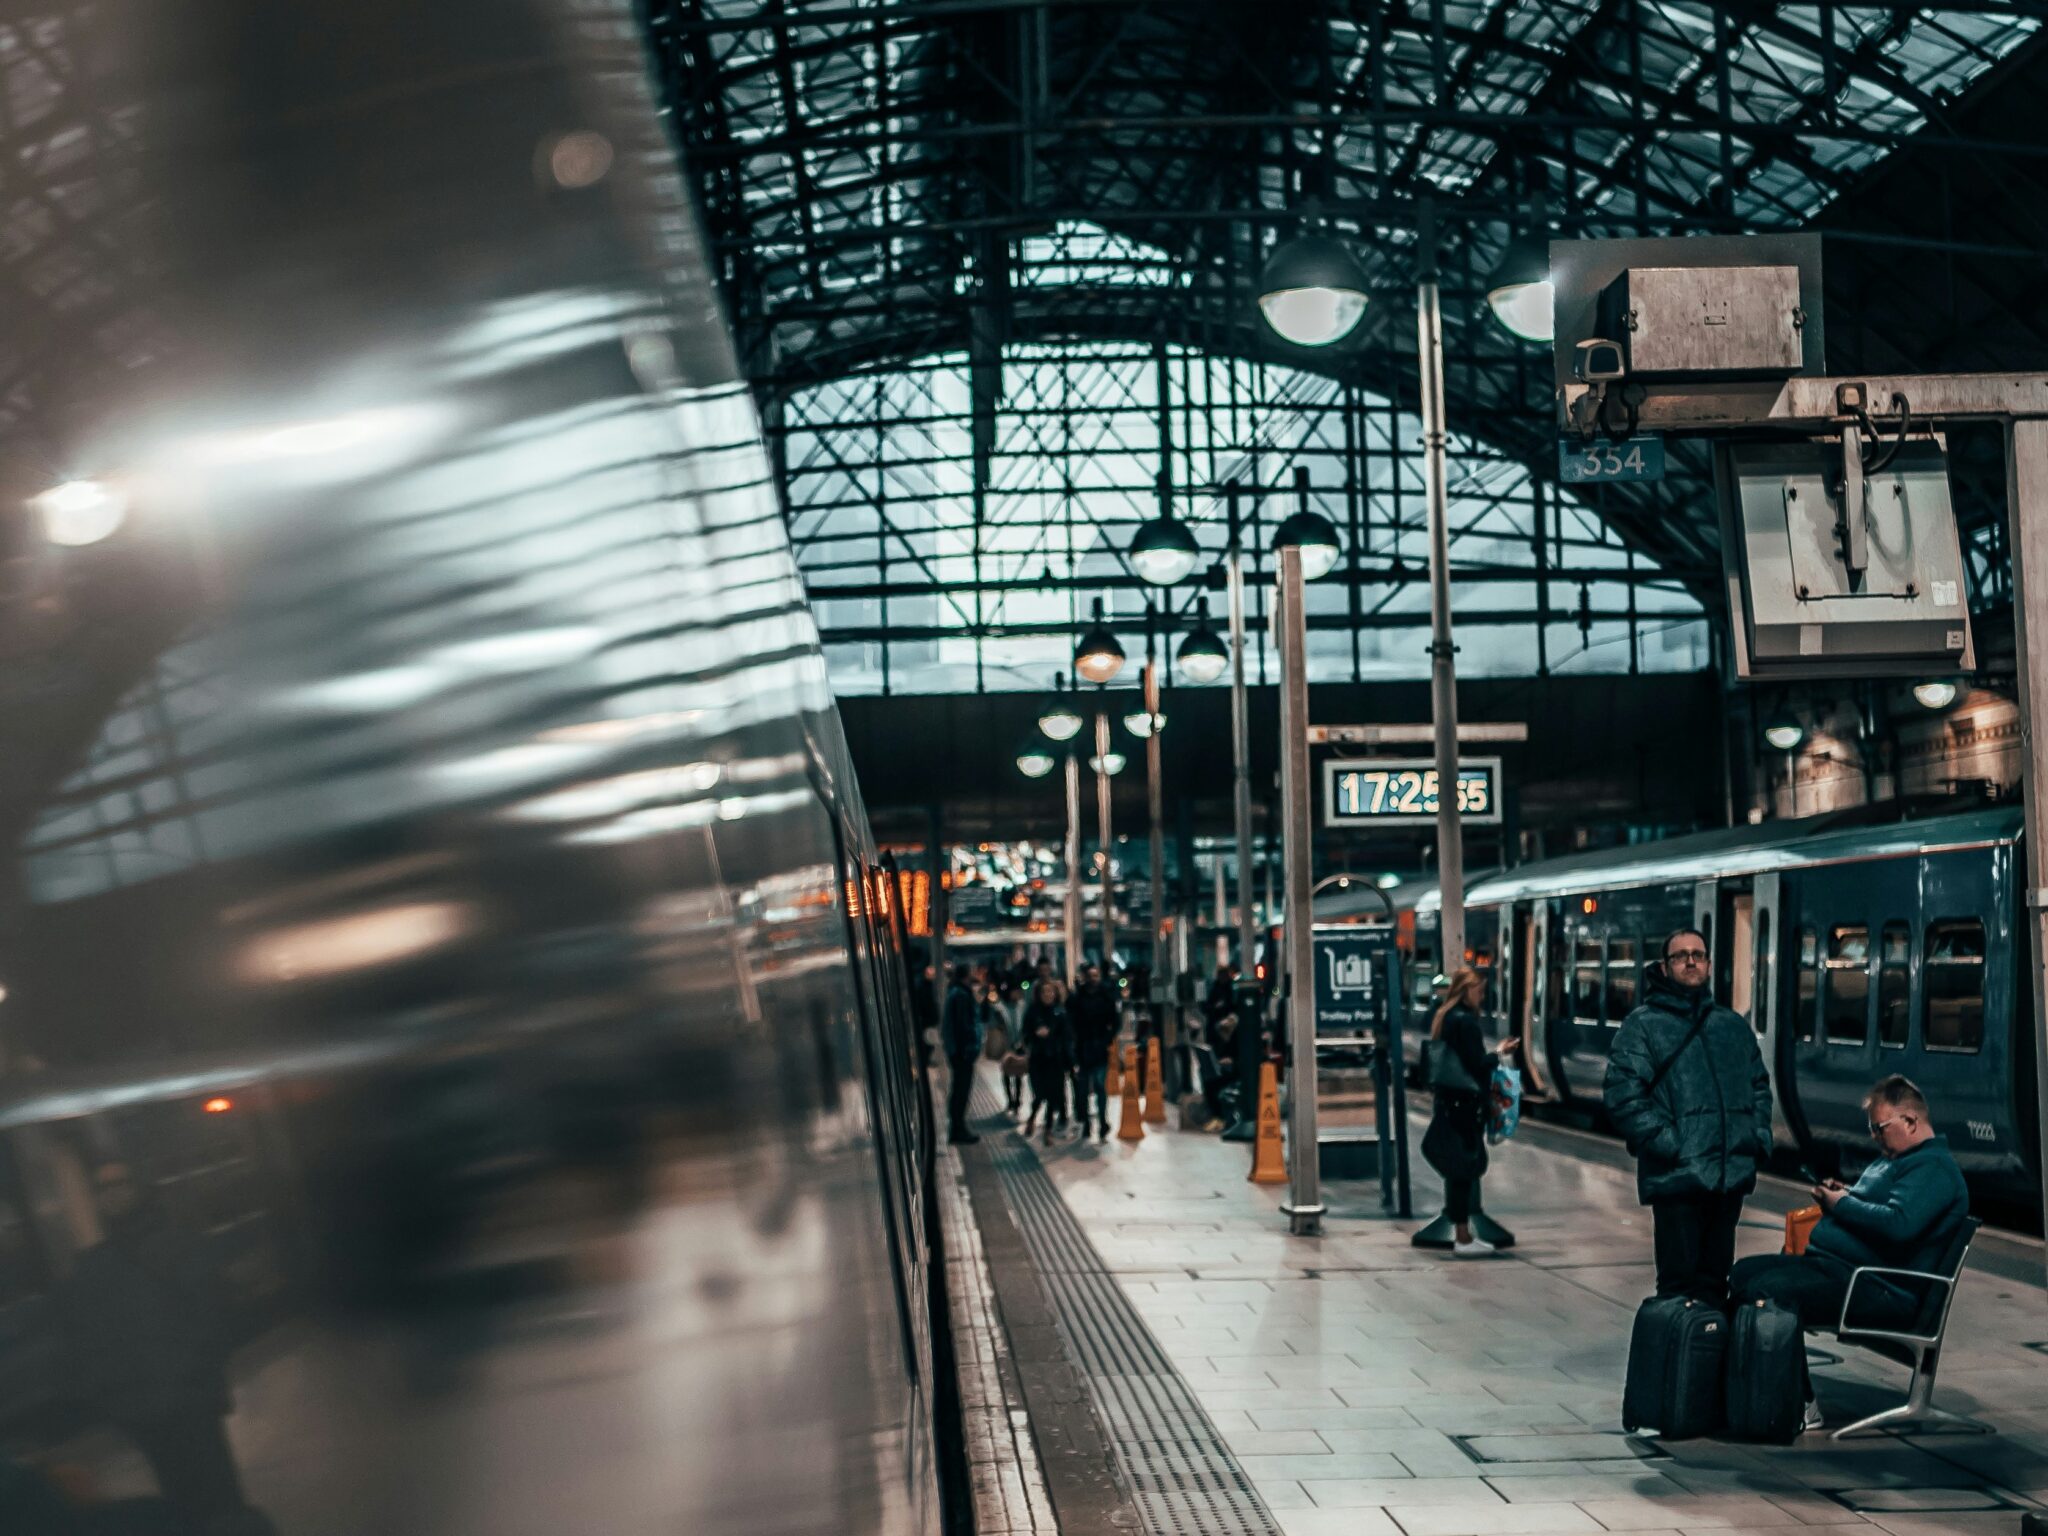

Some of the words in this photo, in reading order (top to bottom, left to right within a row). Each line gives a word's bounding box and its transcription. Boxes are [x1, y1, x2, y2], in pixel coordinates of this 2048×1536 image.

[1582, 446, 1645, 475] 354
[1340, 771, 1439, 813] 17:25
[1319, 1010, 1352, 1023] Trolley
